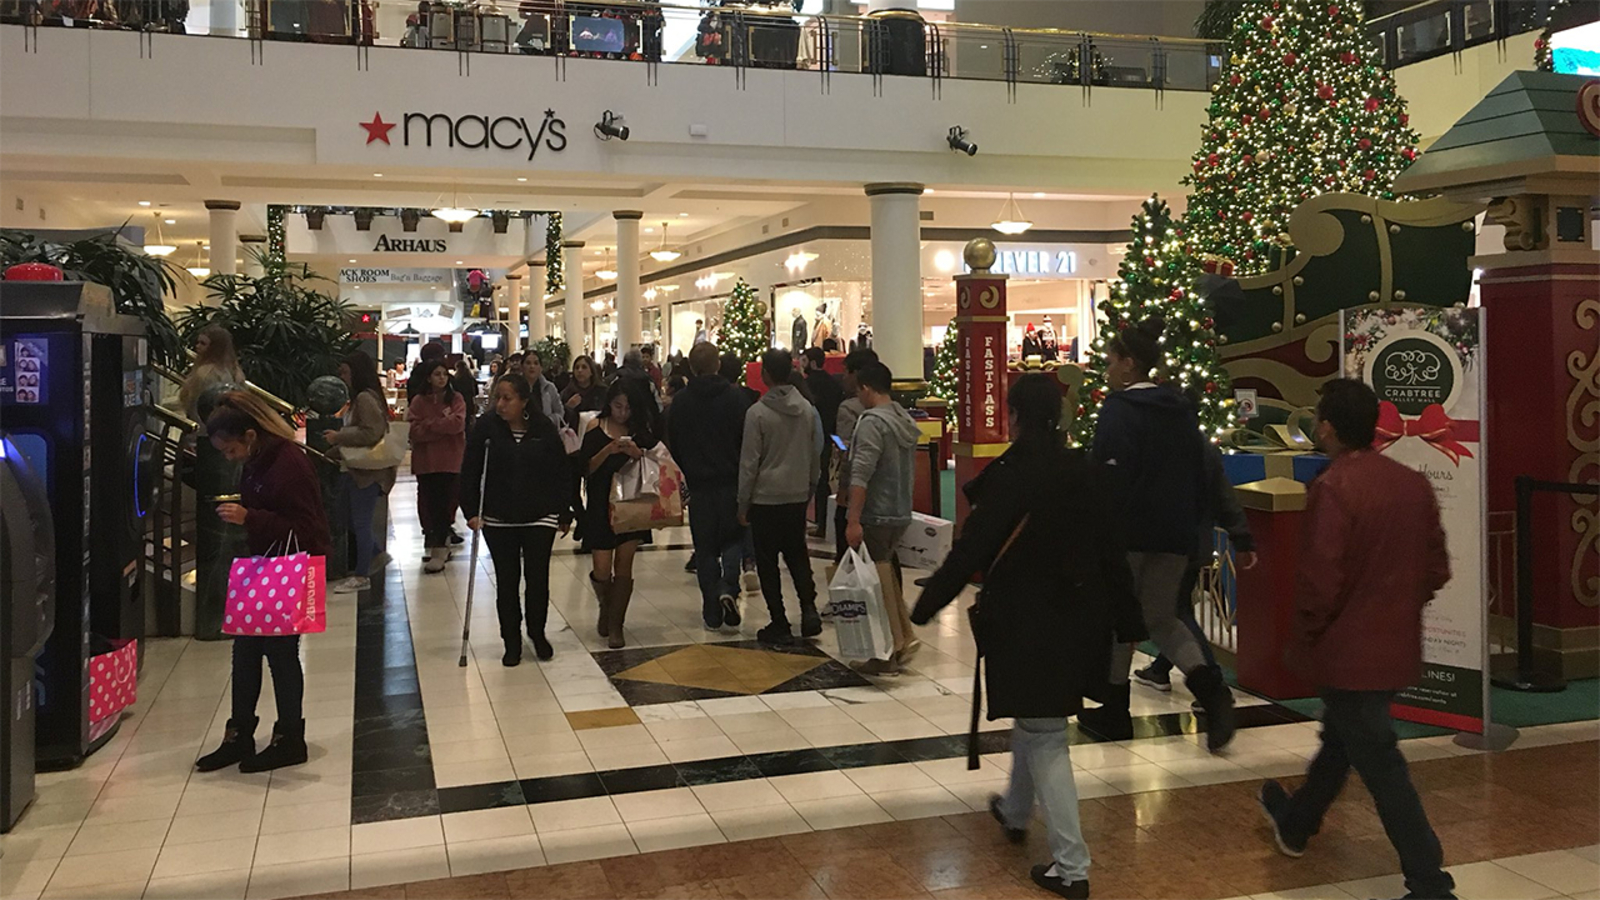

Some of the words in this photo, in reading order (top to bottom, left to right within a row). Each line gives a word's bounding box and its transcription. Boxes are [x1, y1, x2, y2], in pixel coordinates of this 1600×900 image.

[373, 233, 447, 253] ARHAUS
[1056, 250, 1077, 274] 21
[339, 268, 359, 277] ACK
[360, 268, 390, 277] ROOM
[346, 275, 377, 283] SHOES
[984, 336, 995, 427] FASTPASS
[1384, 388, 1441, 398] CRABTREE
